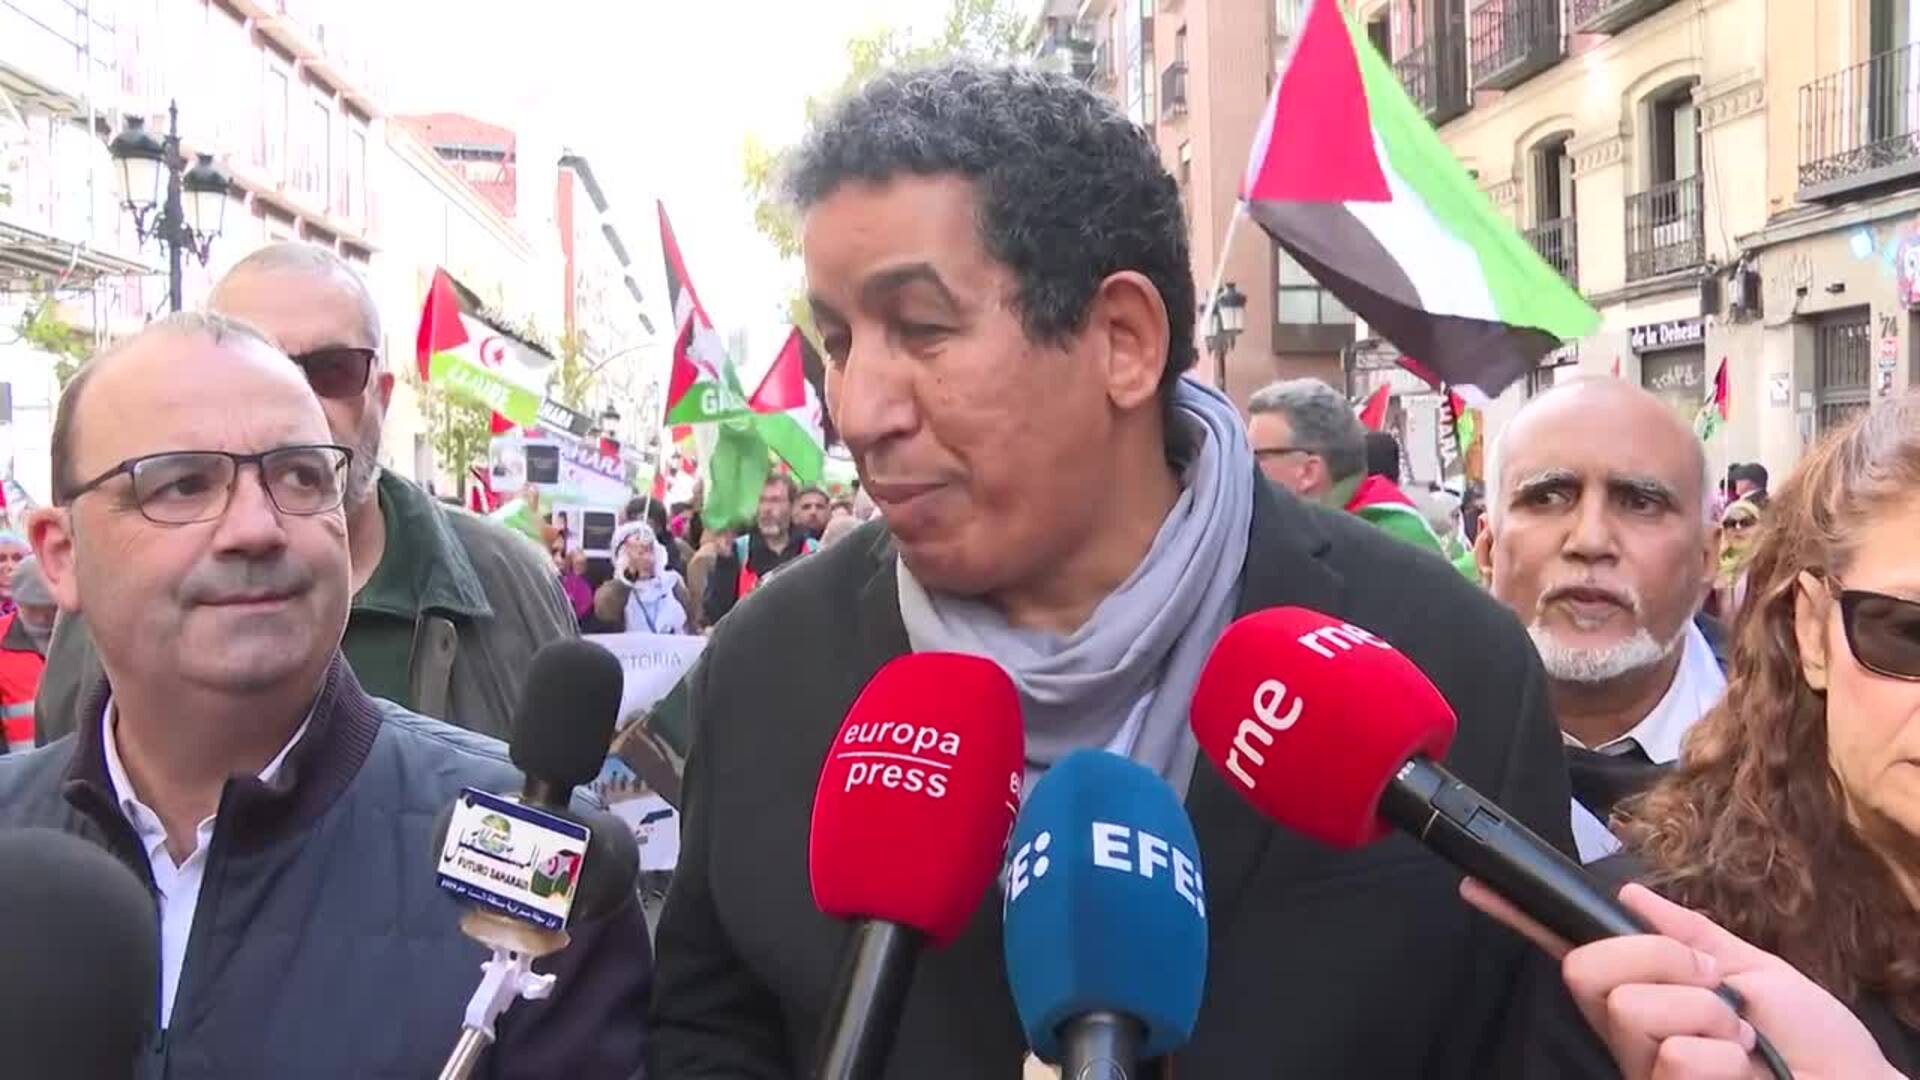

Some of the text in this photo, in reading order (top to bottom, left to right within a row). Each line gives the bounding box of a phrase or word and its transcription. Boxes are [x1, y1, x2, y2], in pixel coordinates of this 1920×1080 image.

[1632, 321, 1701, 347] de la Dehesa
[1297, 622, 1393, 659] rne
[624, 650, 681, 671] TORIA
[843, 721, 961, 756] europa
[1225, 678, 1304, 789] rne
[843, 761, 948, 798] press
[456, 856, 489, 877] FUTURO
